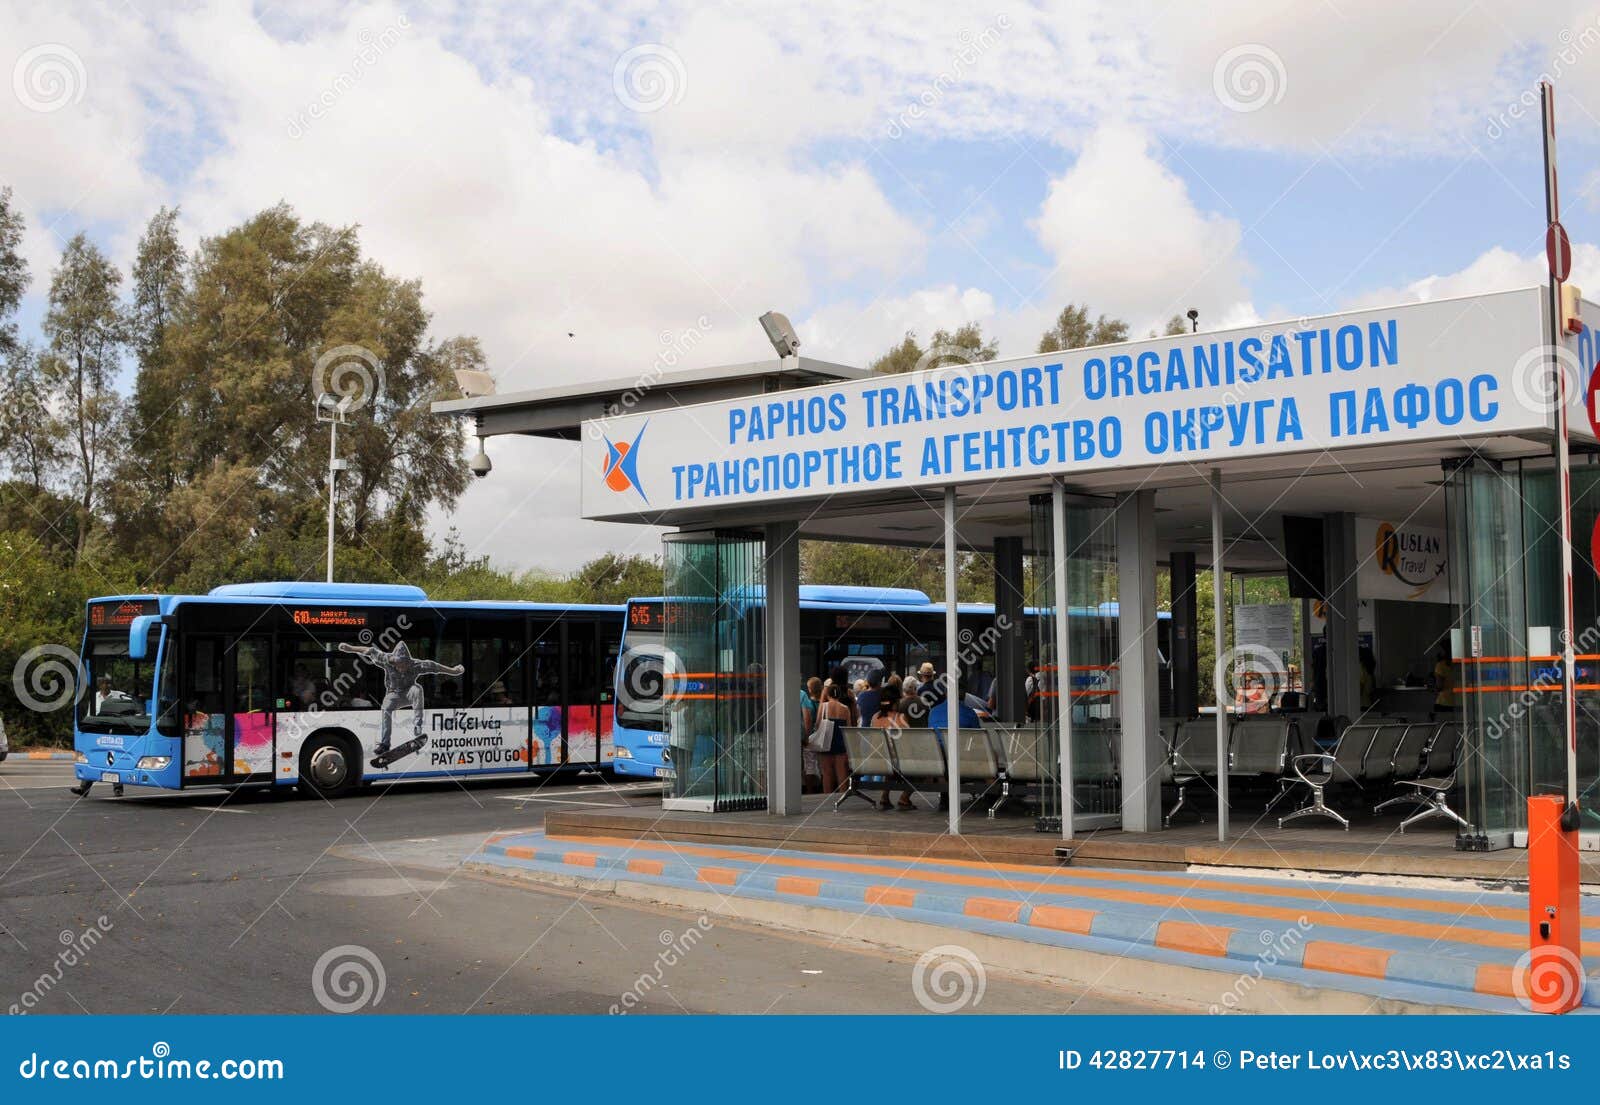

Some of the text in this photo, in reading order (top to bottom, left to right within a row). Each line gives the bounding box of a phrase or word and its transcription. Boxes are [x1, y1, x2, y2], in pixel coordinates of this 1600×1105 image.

[729, 319, 1398, 444] PAPHOS TRANSPORT ORGANISATION
[672, 373, 1499, 501] ТРАНСПОРТНОЕ АГЕНТСТВО ОКРУГА ПАФОС
[1400, 556, 1427, 574] Travel
[294, 610, 310, 624] 610
[432, 712, 501, 734] Παίζει νέα
[431, 732, 503, 751] καρτοκινητή
[431, 749, 520, 765] PAY AS YOU GO
